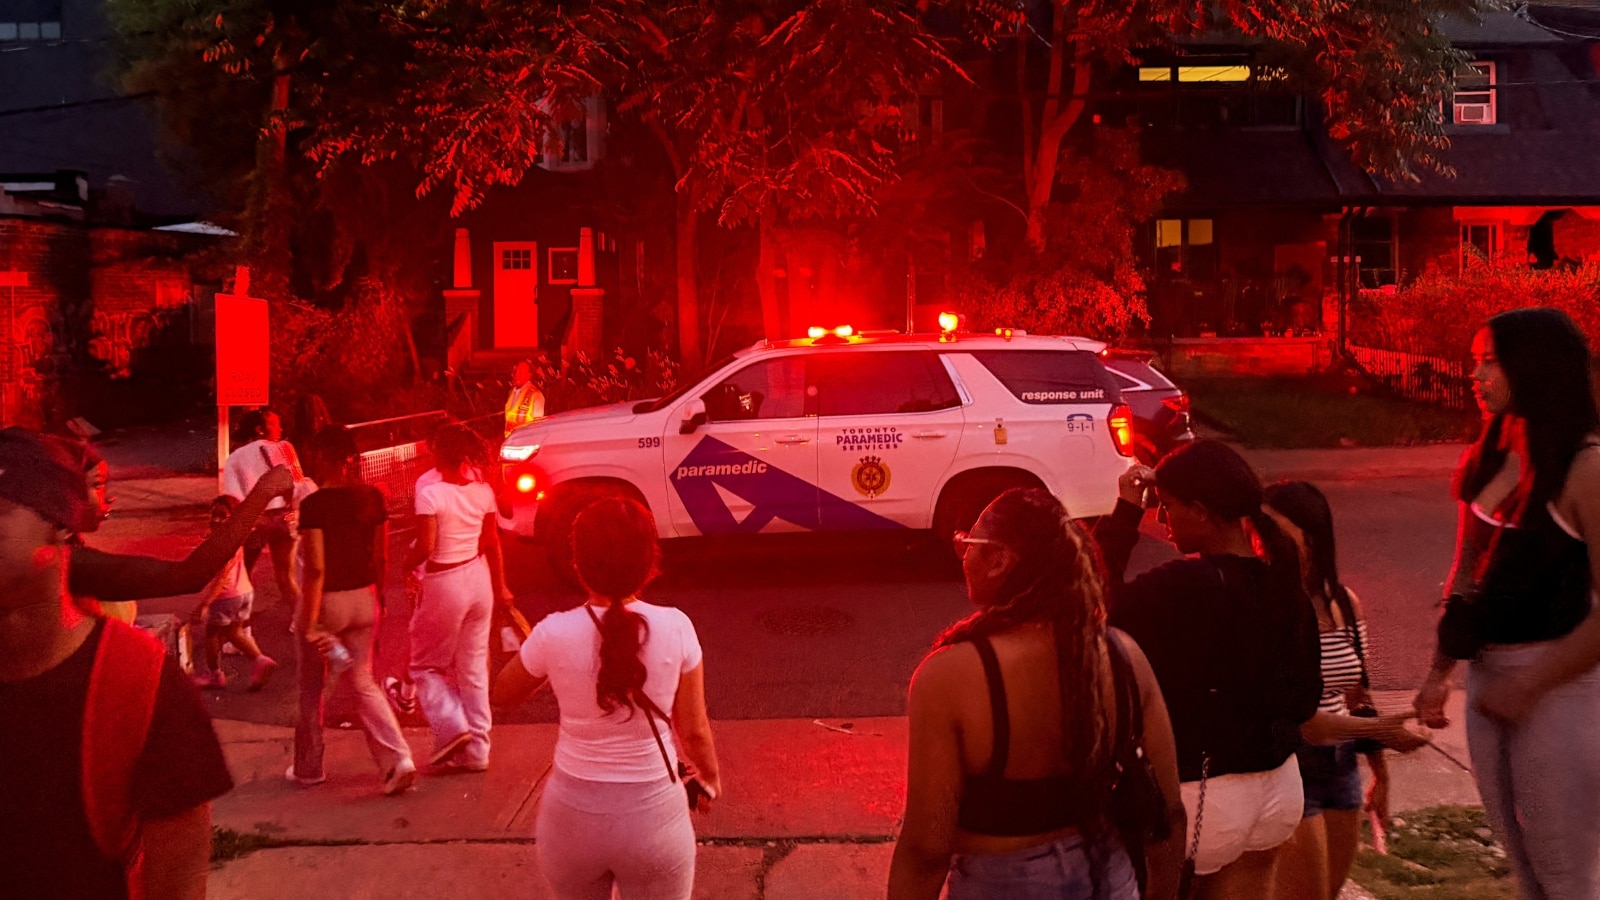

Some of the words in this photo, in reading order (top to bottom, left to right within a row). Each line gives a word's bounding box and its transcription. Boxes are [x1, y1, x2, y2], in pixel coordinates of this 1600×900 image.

[225, 387, 262, 398] CLOSED
[1021, 391, 1077, 402] response
[1080, 389, 1105, 399] unit
[842, 427, 896, 435] TORONTO
[1067, 422, 1095, 432] 9-1-1
[638, 437, 660, 448] 599
[836, 433, 903, 445] PARAMEDIC
[842, 443, 898, 451] SERVICES
[676, 460, 768, 480] paramedic
